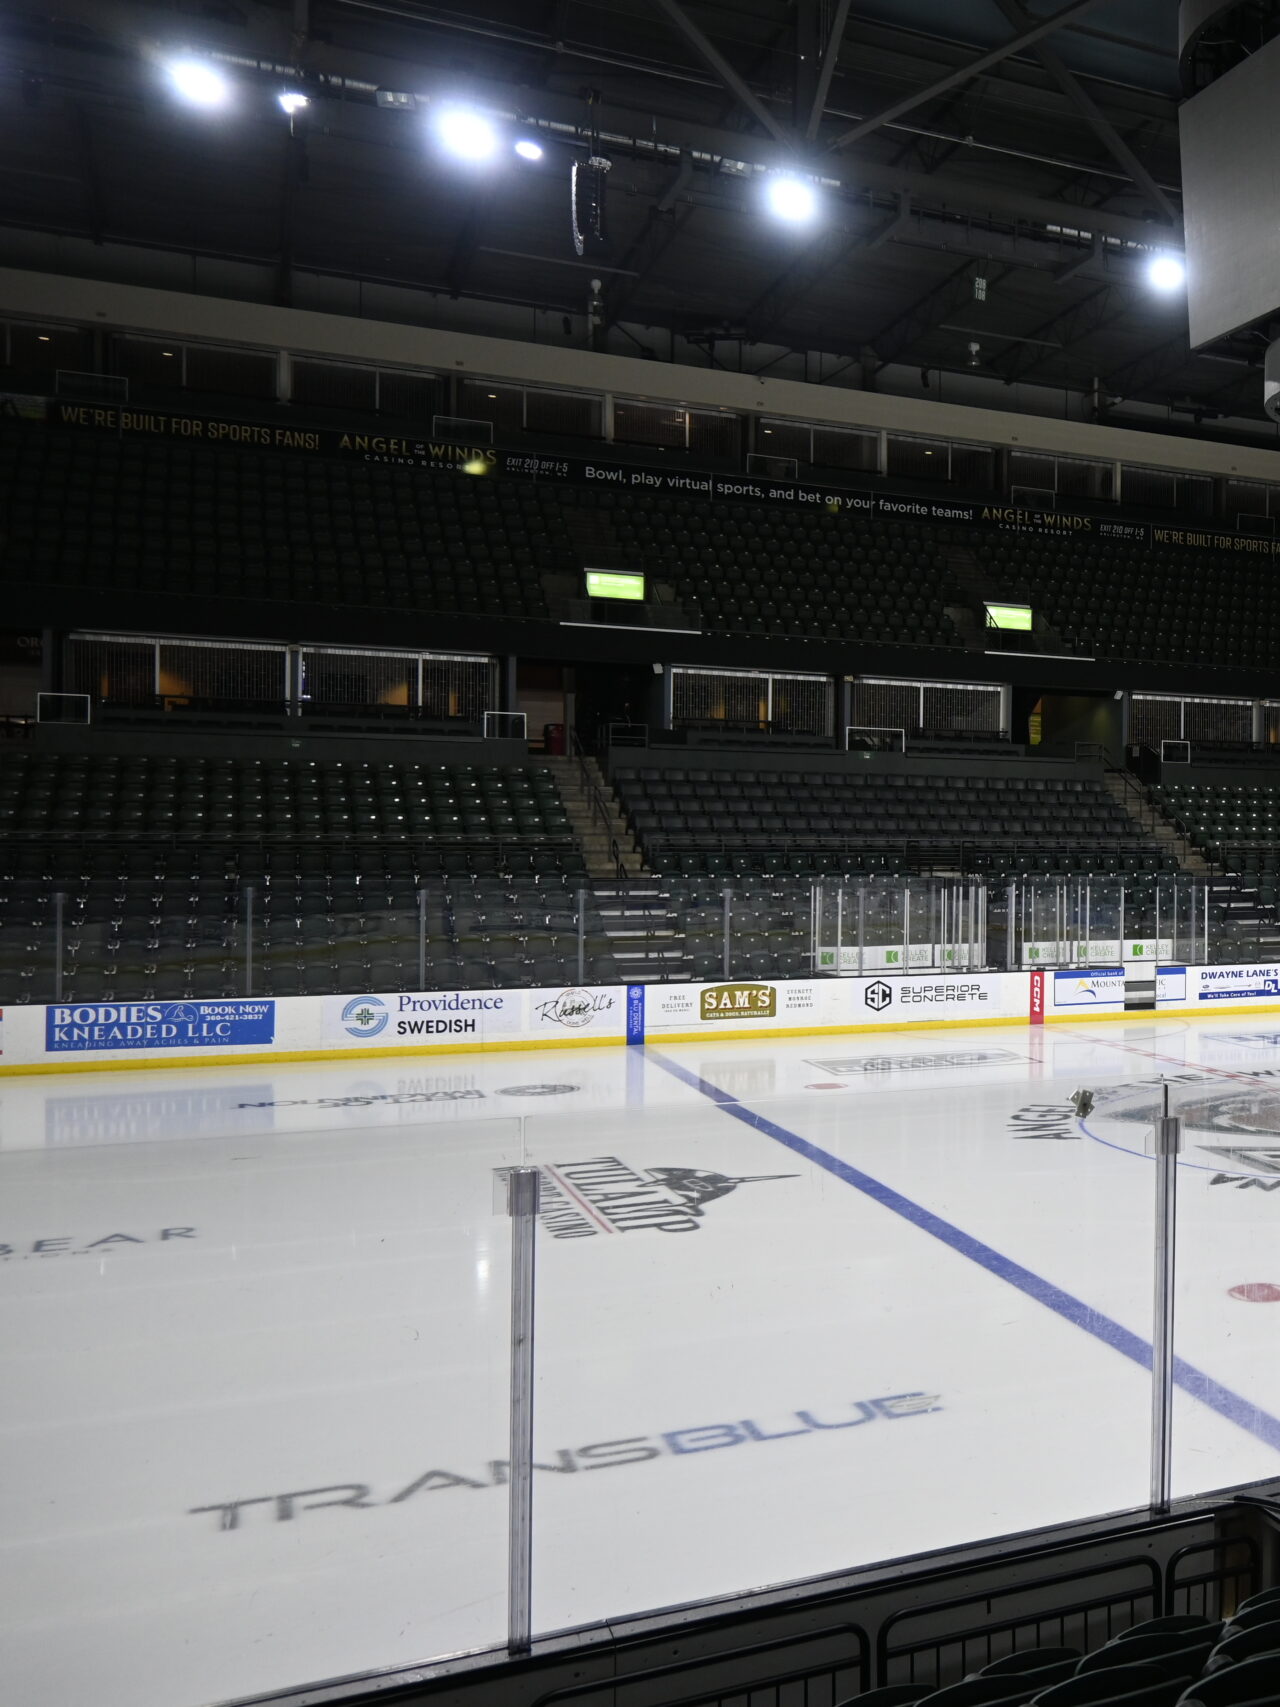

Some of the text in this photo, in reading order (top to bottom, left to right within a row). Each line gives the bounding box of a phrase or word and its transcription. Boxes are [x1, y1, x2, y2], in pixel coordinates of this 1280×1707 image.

[60, 405, 320, 451] WE'RE BUILT FOR SPORTS FANS!
[339, 433, 410, 456] ANGEL
[429, 443, 497, 465] WINDS
[364, 454, 472, 472] CASINO RESOR
[506, 457, 522, 467] EXIT
[541, 461, 554, 469] OFF
[585, 466, 973, 520] Bowl, play virtual sports, and bet on your favorite teams!
[981, 507, 1031, 524] ANGEL
[1043, 513, 1092, 531] WINDS
[1100, 524, 1112, 532] EXIT
[998, 523, 1073, 537] CASINO RESORT
[1153, 529, 1185, 545] WE'RE
[1187, 533, 1212, 549] BUILT
[1214, 536, 1232, 550] FOR
[1234, 538, 1270, 554] SPORTS
[1201, 970, 1244, 979] DWAYNE
[1246, 969, 1278, 978] LANE'S
[901, 984, 981, 994] SUPERIOR
[901, 993, 988, 1003] CONCRETE
[398, 993, 504, 1012] Providence
[535, 994, 615, 1022] Russell's
[704, 989, 771, 1010] SAM'S
[53, 1006, 162, 1026] BODIES
[200, 1004, 269, 1015] BOOK NOW
[53, 1022, 231, 1041] KNEADED LLC
[397, 1018, 476, 1035] SWEDISH
[54, 1040, 114, 1049] KNEADING
[119, 1039, 148, 1047] AWAY
[154, 1037, 191, 1046] ACHES
[205, 1036, 229, 1044] PAIN
[187, 1390, 943, 1532] TRANSBLUE
